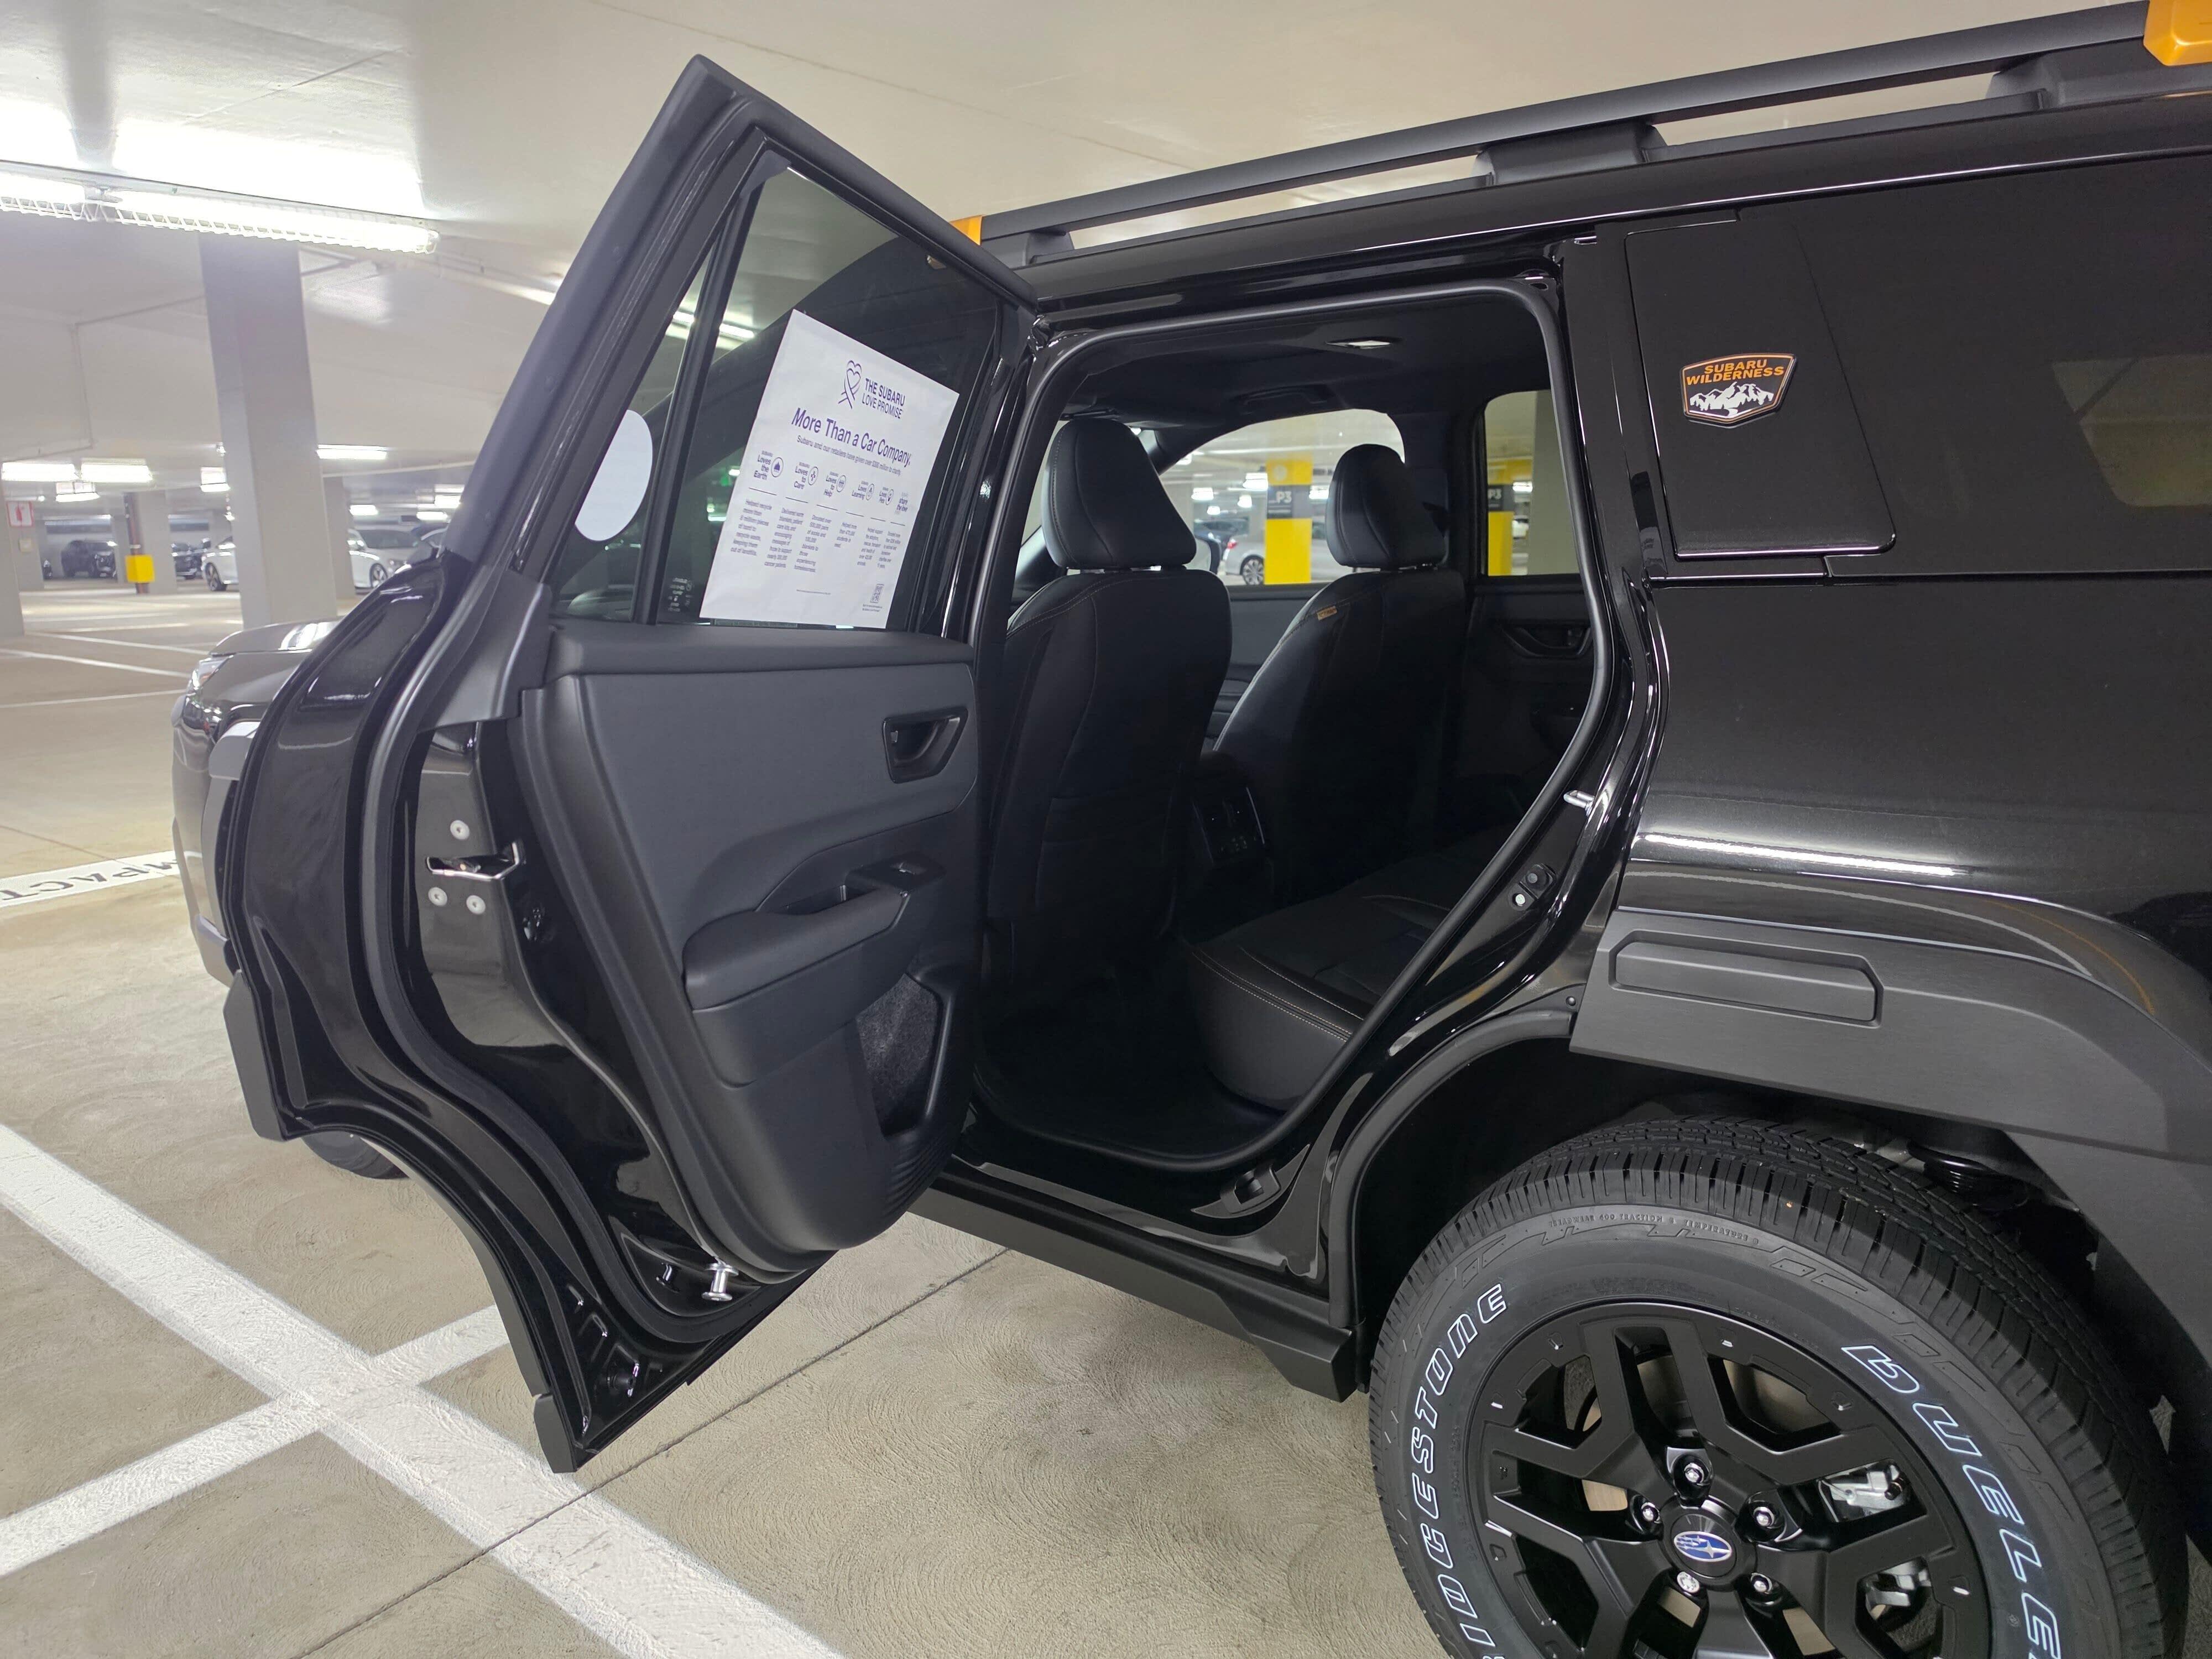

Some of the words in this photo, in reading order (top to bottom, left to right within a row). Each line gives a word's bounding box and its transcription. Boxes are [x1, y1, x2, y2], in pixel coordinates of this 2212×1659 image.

[1704, 359, 1767, 374] SUBARU
[1687, 367, 1784, 385] WILDERNESS
[865, 378, 878, 395] THE
[878, 385, 905, 406] SUBARU
[862, 393, 877, 409] LOVE
[877, 399, 902, 419] PROMISE
[791, 408, 821, 434] More
[825, 418, 851, 444] Than
[852, 434, 859, 447] a
[860, 432, 878, 452] Car
[877, 439, 911, 468] Company.
[797, 435, 813, 447] Subaru
[813, 442, 823, 450] and
[831, 448, 847, 458] retailers
[757, 455, 771, 465] Loves
[753, 470, 768, 480] Earth
[761, 464, 769, 473] the
[795, 466, 808, 476] Loves
[794, 481, 805, 489] Care
[826, 476, 837, 484] Loves
[823, 489, 833, 497] Help
[851, 490, 865, 500] Learning
[858, 484, 867, 493] Loves
[1275, 491, 1292, 504] P3
[1548, 1215, 1595, 1227] TREADWEAR
[1619, 1213, 1665, 1222] TRACTION
[1683, 1219, 1749, 1241] TEMPERATURE
[1411, 1283, 1507, 1659] IDGESTONE
[1841, 1345, 2061, 1659] DUELE
